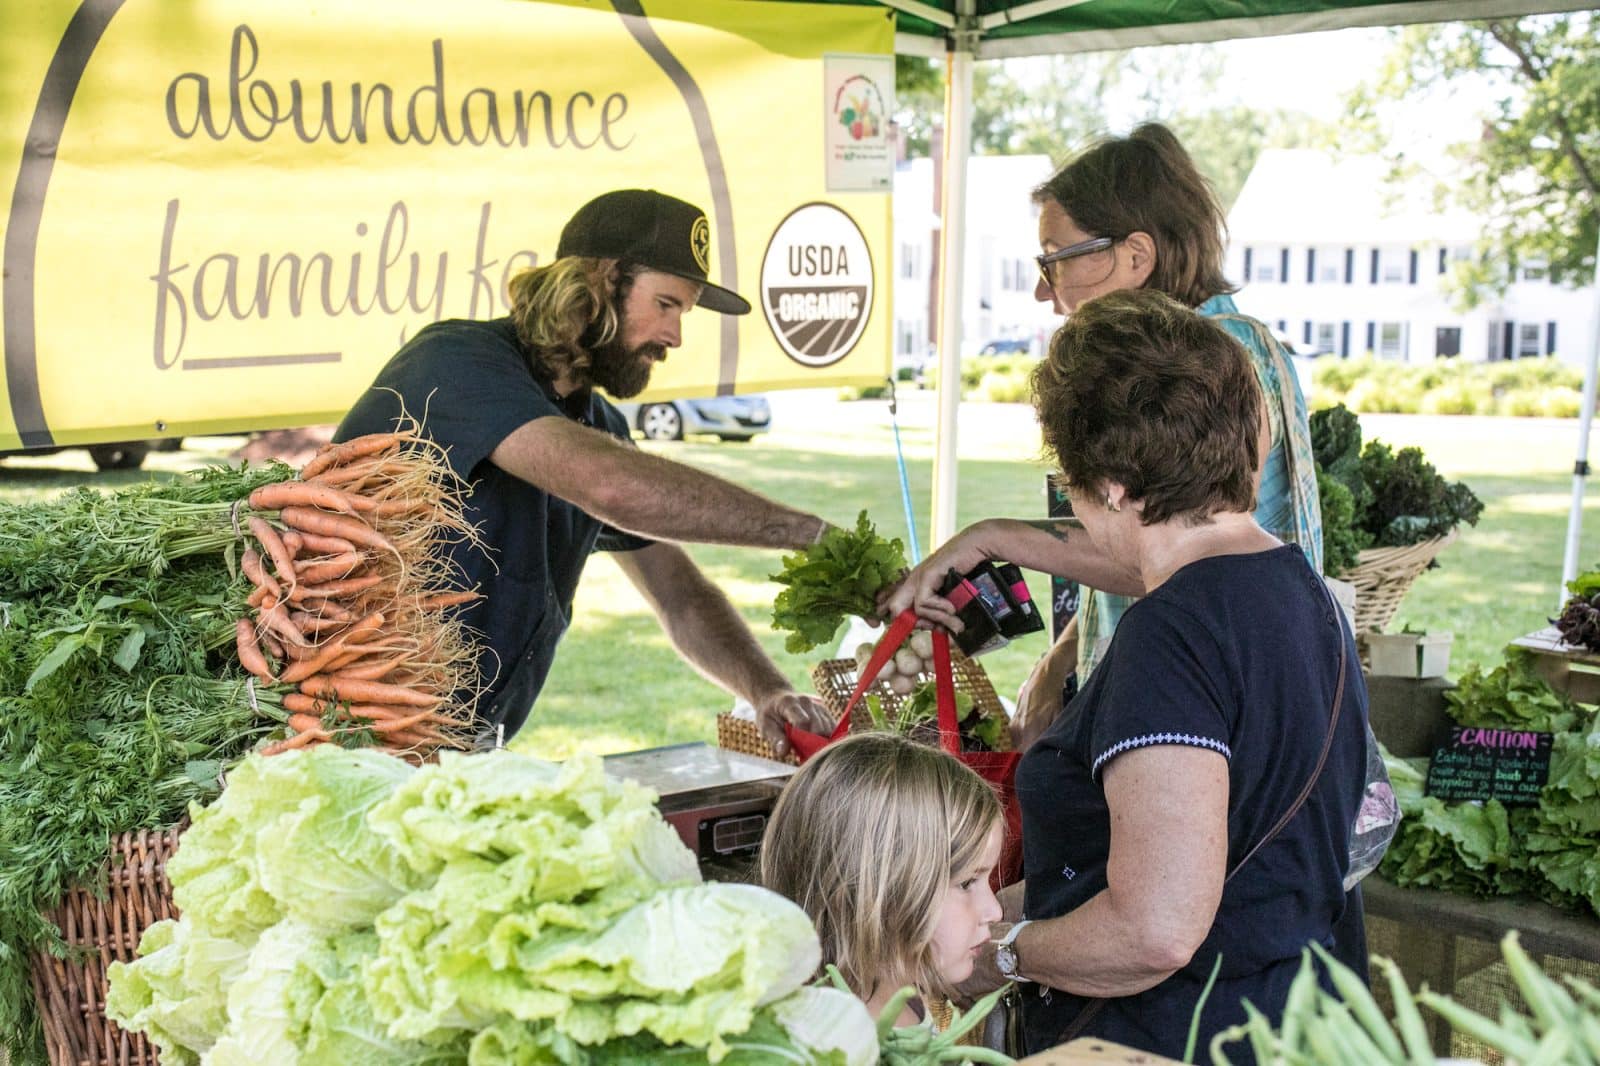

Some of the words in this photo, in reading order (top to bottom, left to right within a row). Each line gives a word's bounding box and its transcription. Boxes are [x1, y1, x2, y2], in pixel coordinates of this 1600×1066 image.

[165, 24, 636, 151] abundance
[788, 245, 849, 277] USDA
[149, 197, 448, 371] family
[778, 291, 860, 322] ORGANIC
[1460, 728, 1537, 749] CAUTION
